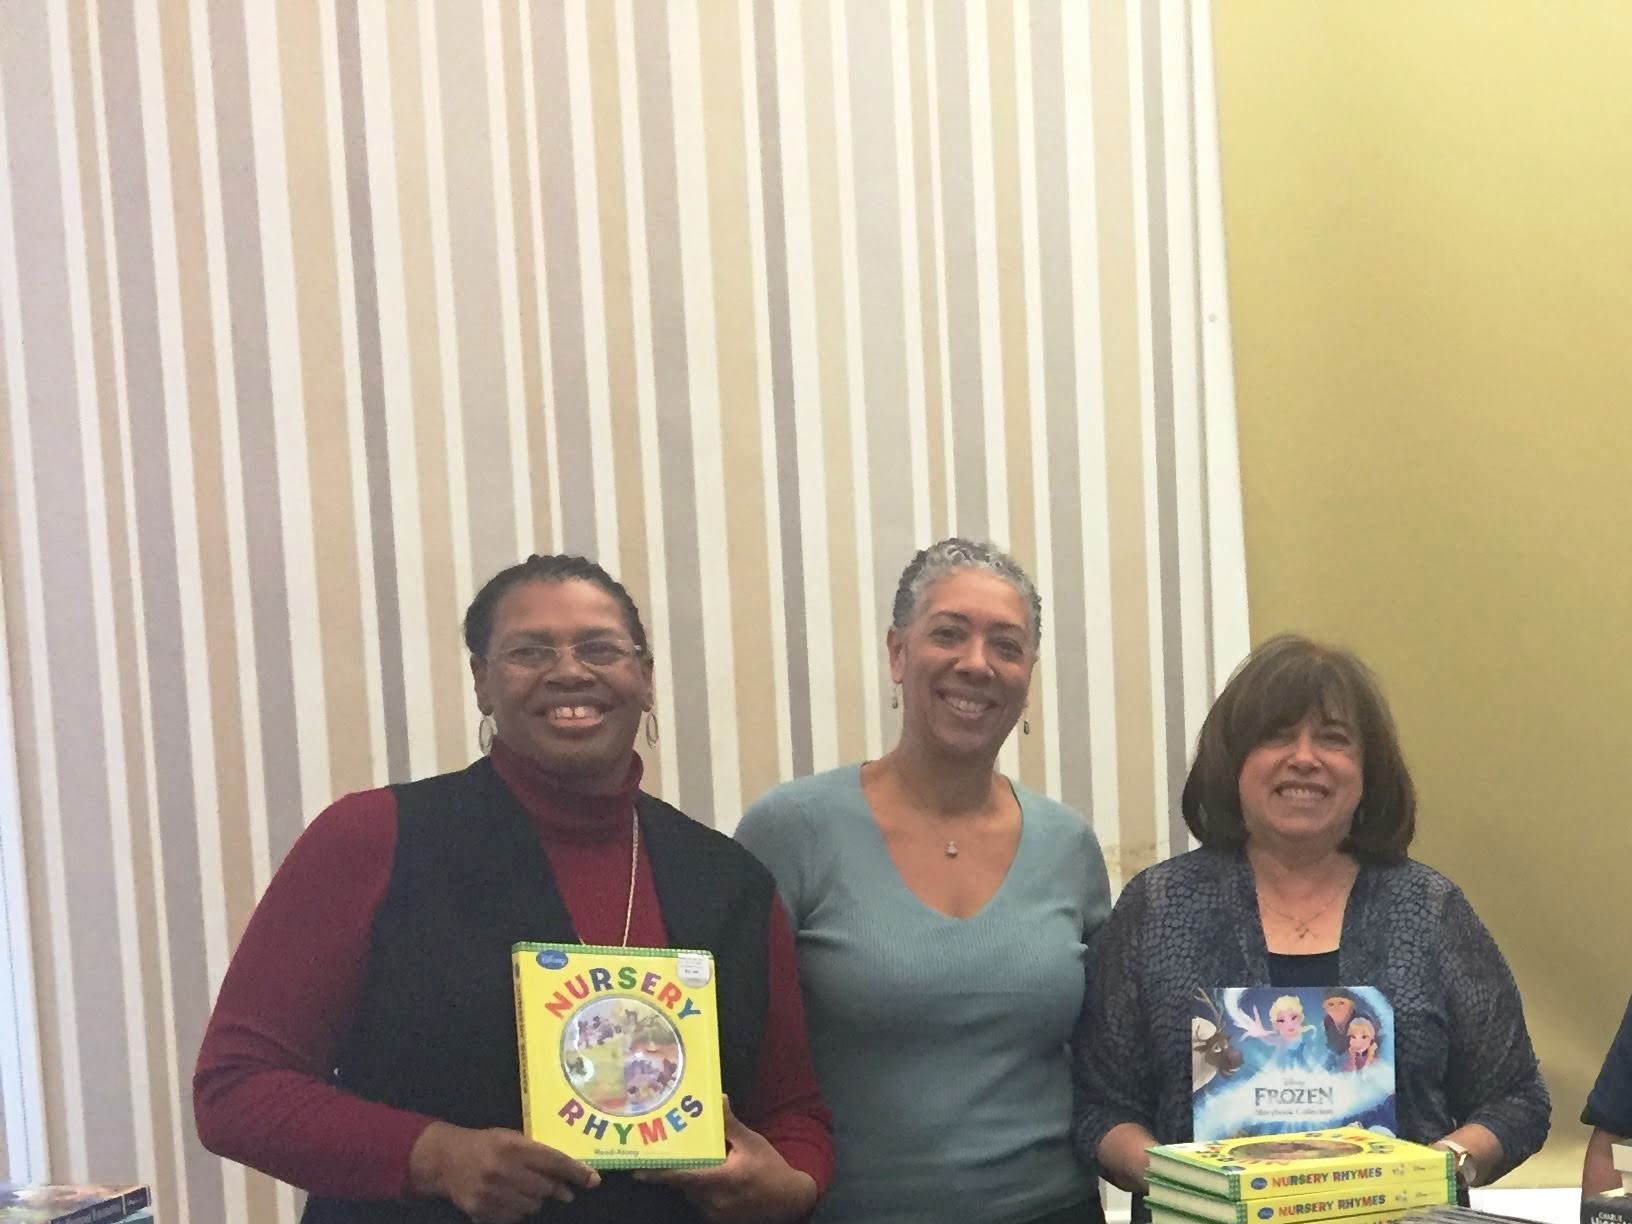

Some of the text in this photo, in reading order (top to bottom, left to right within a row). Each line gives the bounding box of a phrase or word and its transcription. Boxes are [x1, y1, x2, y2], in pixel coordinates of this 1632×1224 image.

[545, 967, 701, 1020] NURSERY
[1255, 1087, 1334, 1106] FROZEN
[558, 1095, 703, 1146] RHYMES
[1272, 1167, 1382, 1188] NURSERY RHYMES
[1279, 1195, 1385, 1217] NURSERY RHYMES
